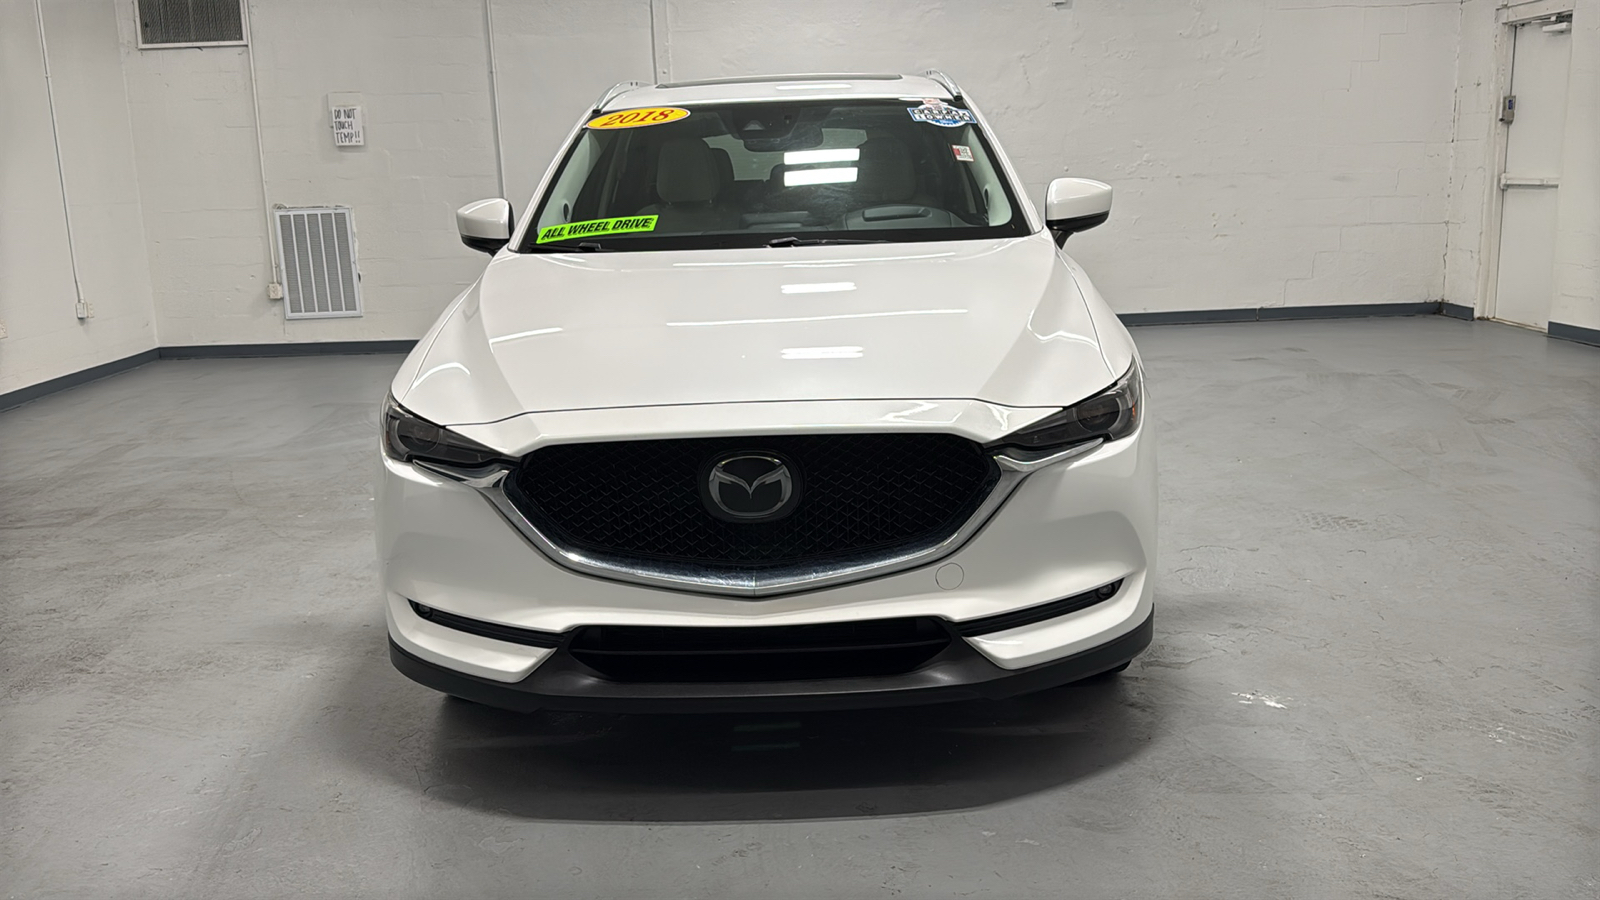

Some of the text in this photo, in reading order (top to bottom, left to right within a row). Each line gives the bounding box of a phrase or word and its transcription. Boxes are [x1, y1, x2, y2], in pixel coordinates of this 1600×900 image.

[334, 108, 357, 120] DO NOT
[600, 109, 675, 127] 2018
[334, 120, 353, 131] TOUCH
[541, 217, 655, 240] ALL WHEEL DRIVE
